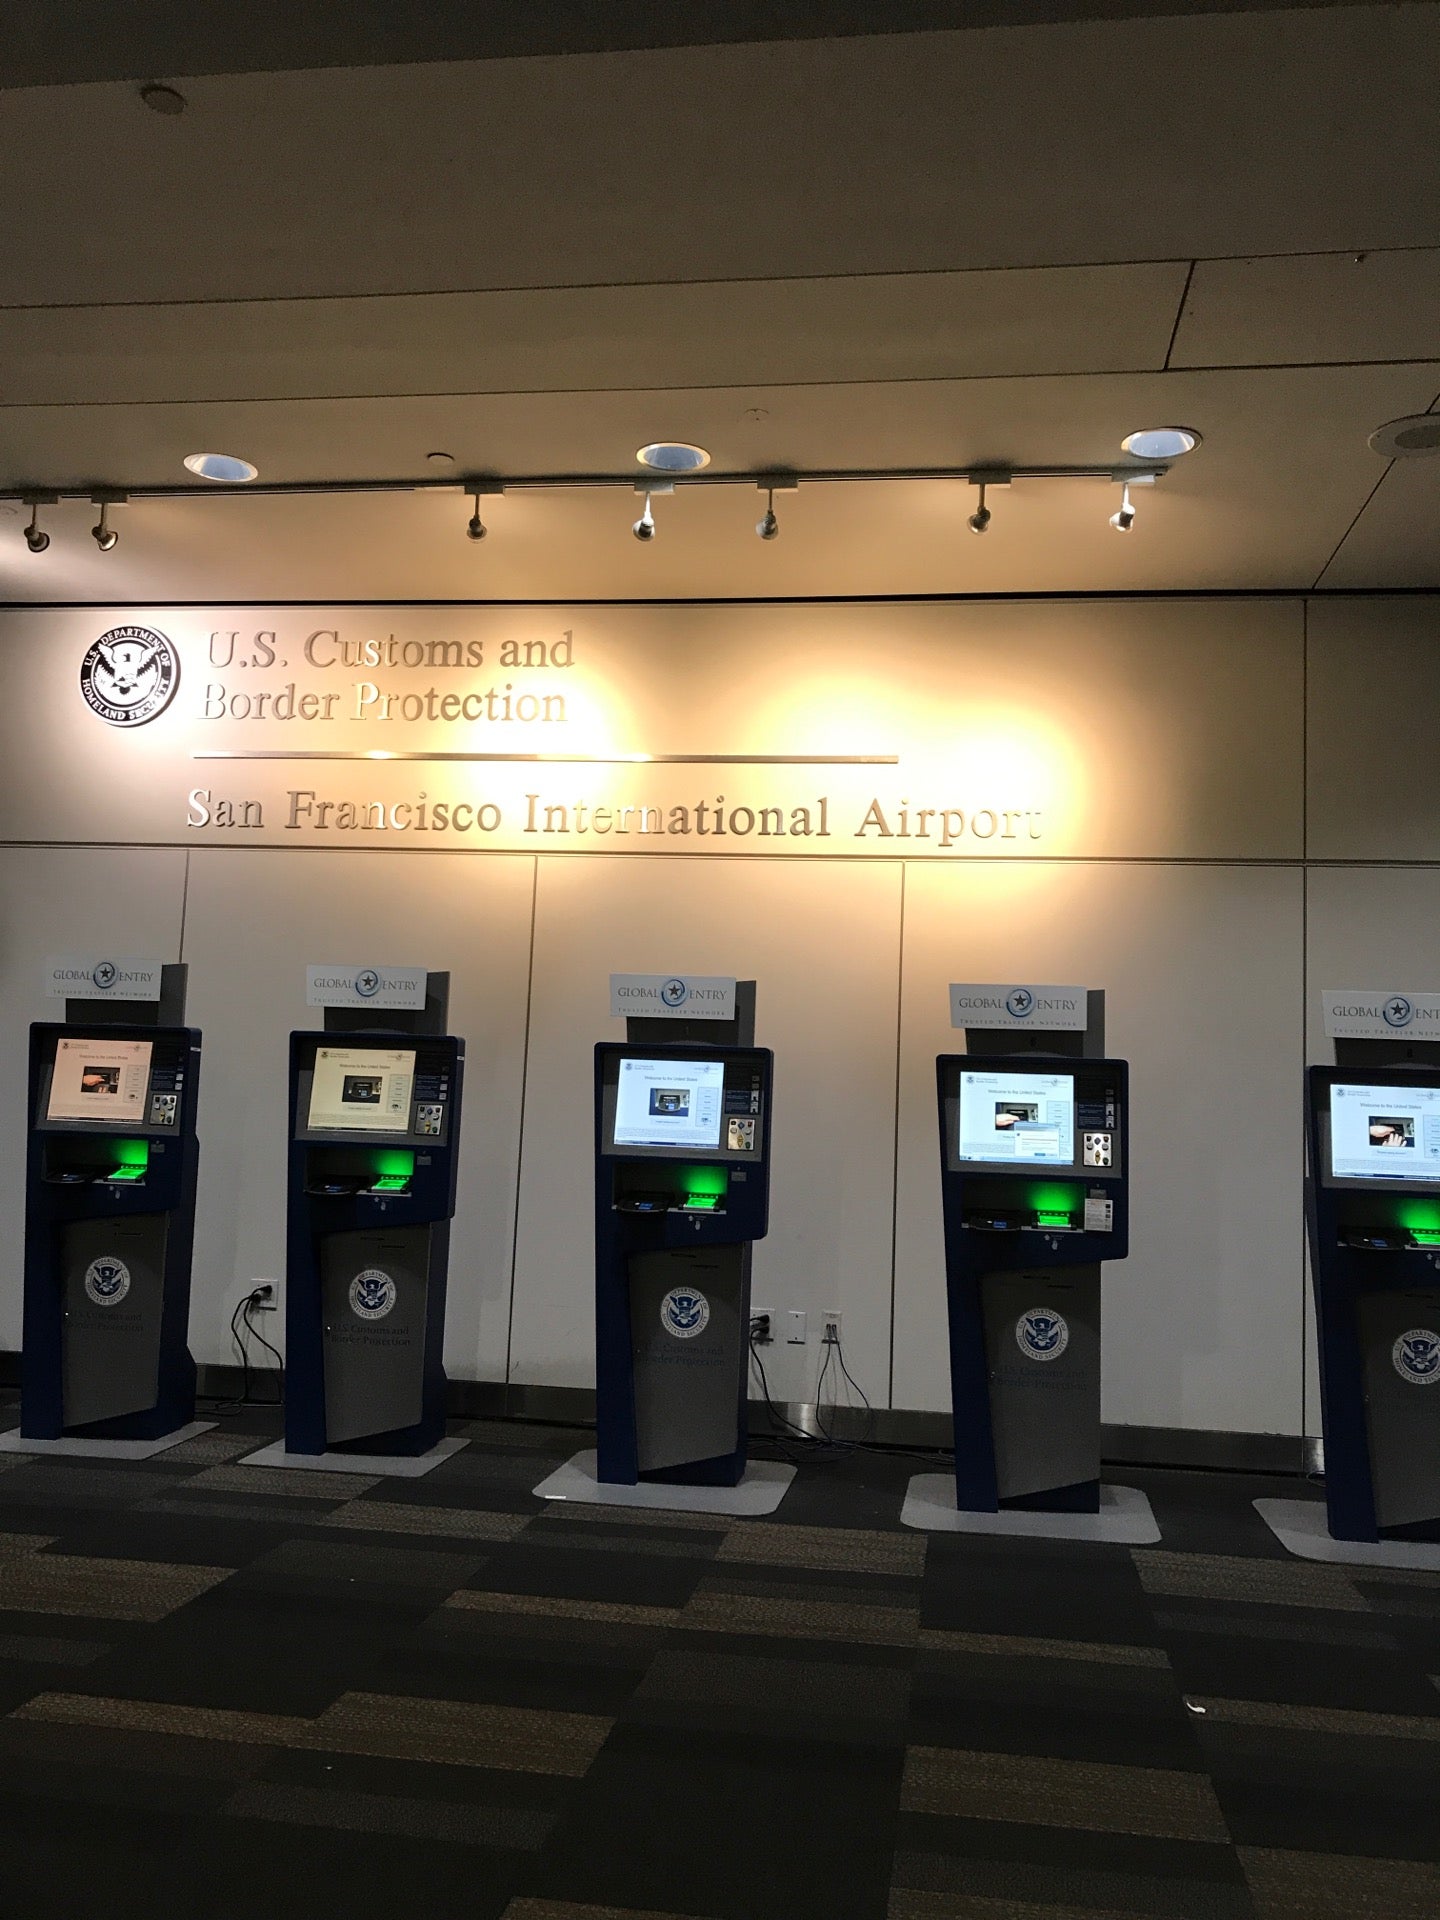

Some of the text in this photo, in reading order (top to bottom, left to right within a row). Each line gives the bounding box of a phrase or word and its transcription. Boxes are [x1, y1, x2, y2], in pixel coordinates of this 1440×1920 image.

[84, 628, 171, 667] U.S. DEPARTMENT OF
[205, 629, 575, 668] U.S. Customs and
[82, 678, 126, 720] HOMELAND
[197, 682, 569, 723] Border Protection
[186, 788, 1043, 847] San Francisco International Airport
[53, 969, 154, 983] GLOBAL ENTRY
[313, 977, 419, 991] GLOBAL ENTRY
[617, 986, 727, 1001] GLOBAL ENTRY
[958, 997, 1078, 1011] GLOBAL ENTRY
[1332, 1005, 1381, 1018] GLOBAL
